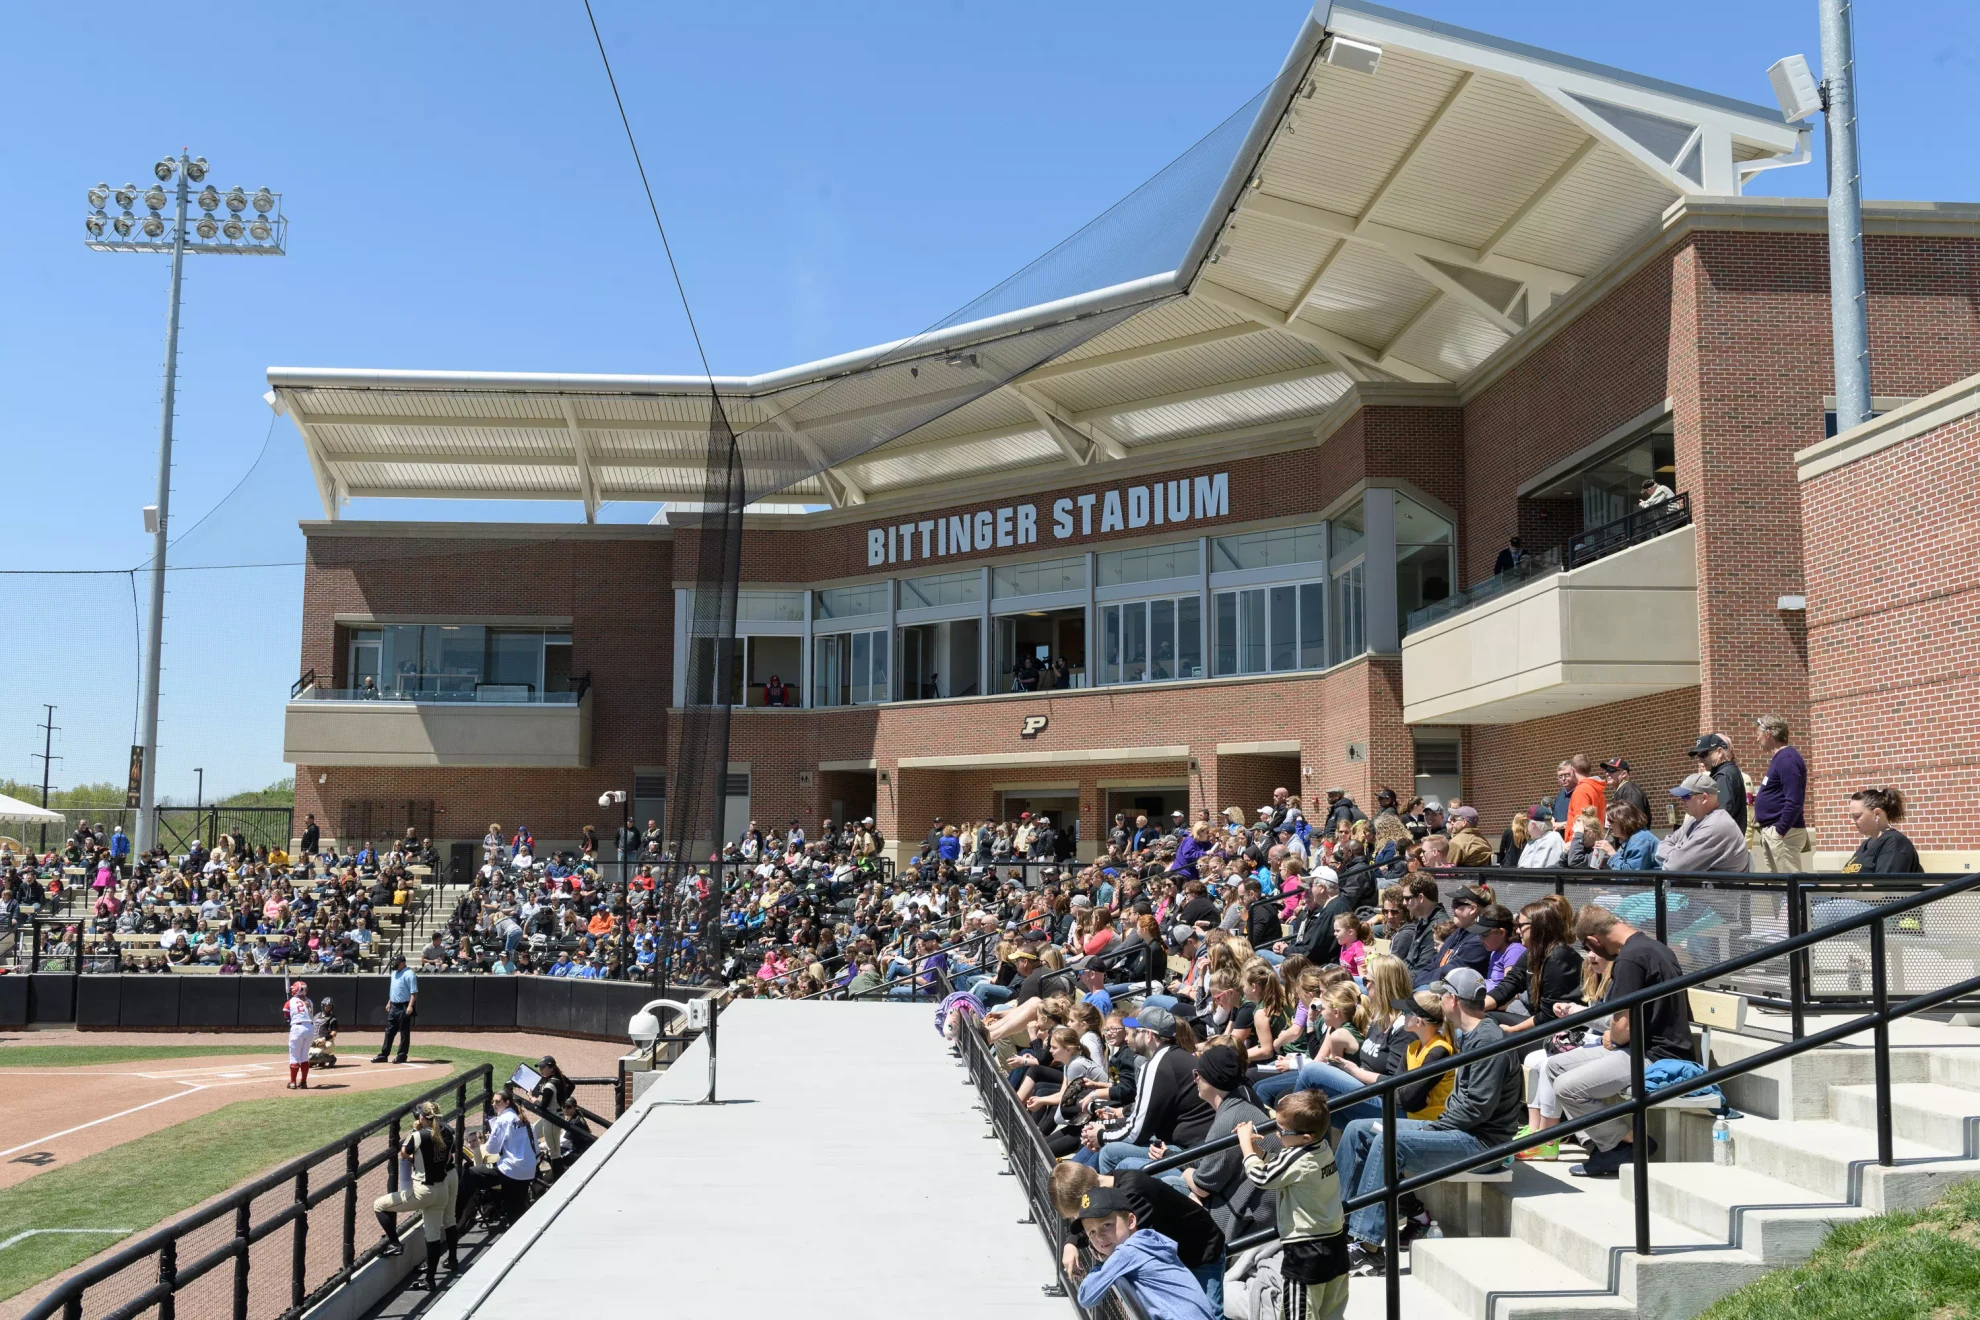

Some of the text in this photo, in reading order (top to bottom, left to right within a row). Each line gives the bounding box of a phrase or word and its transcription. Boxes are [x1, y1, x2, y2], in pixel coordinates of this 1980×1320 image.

[868, 472, 1229, 567] BITTINGER STADIUM
[1021, 715, 1048, 739] P
[296, 1000, 306, 1013] 2
